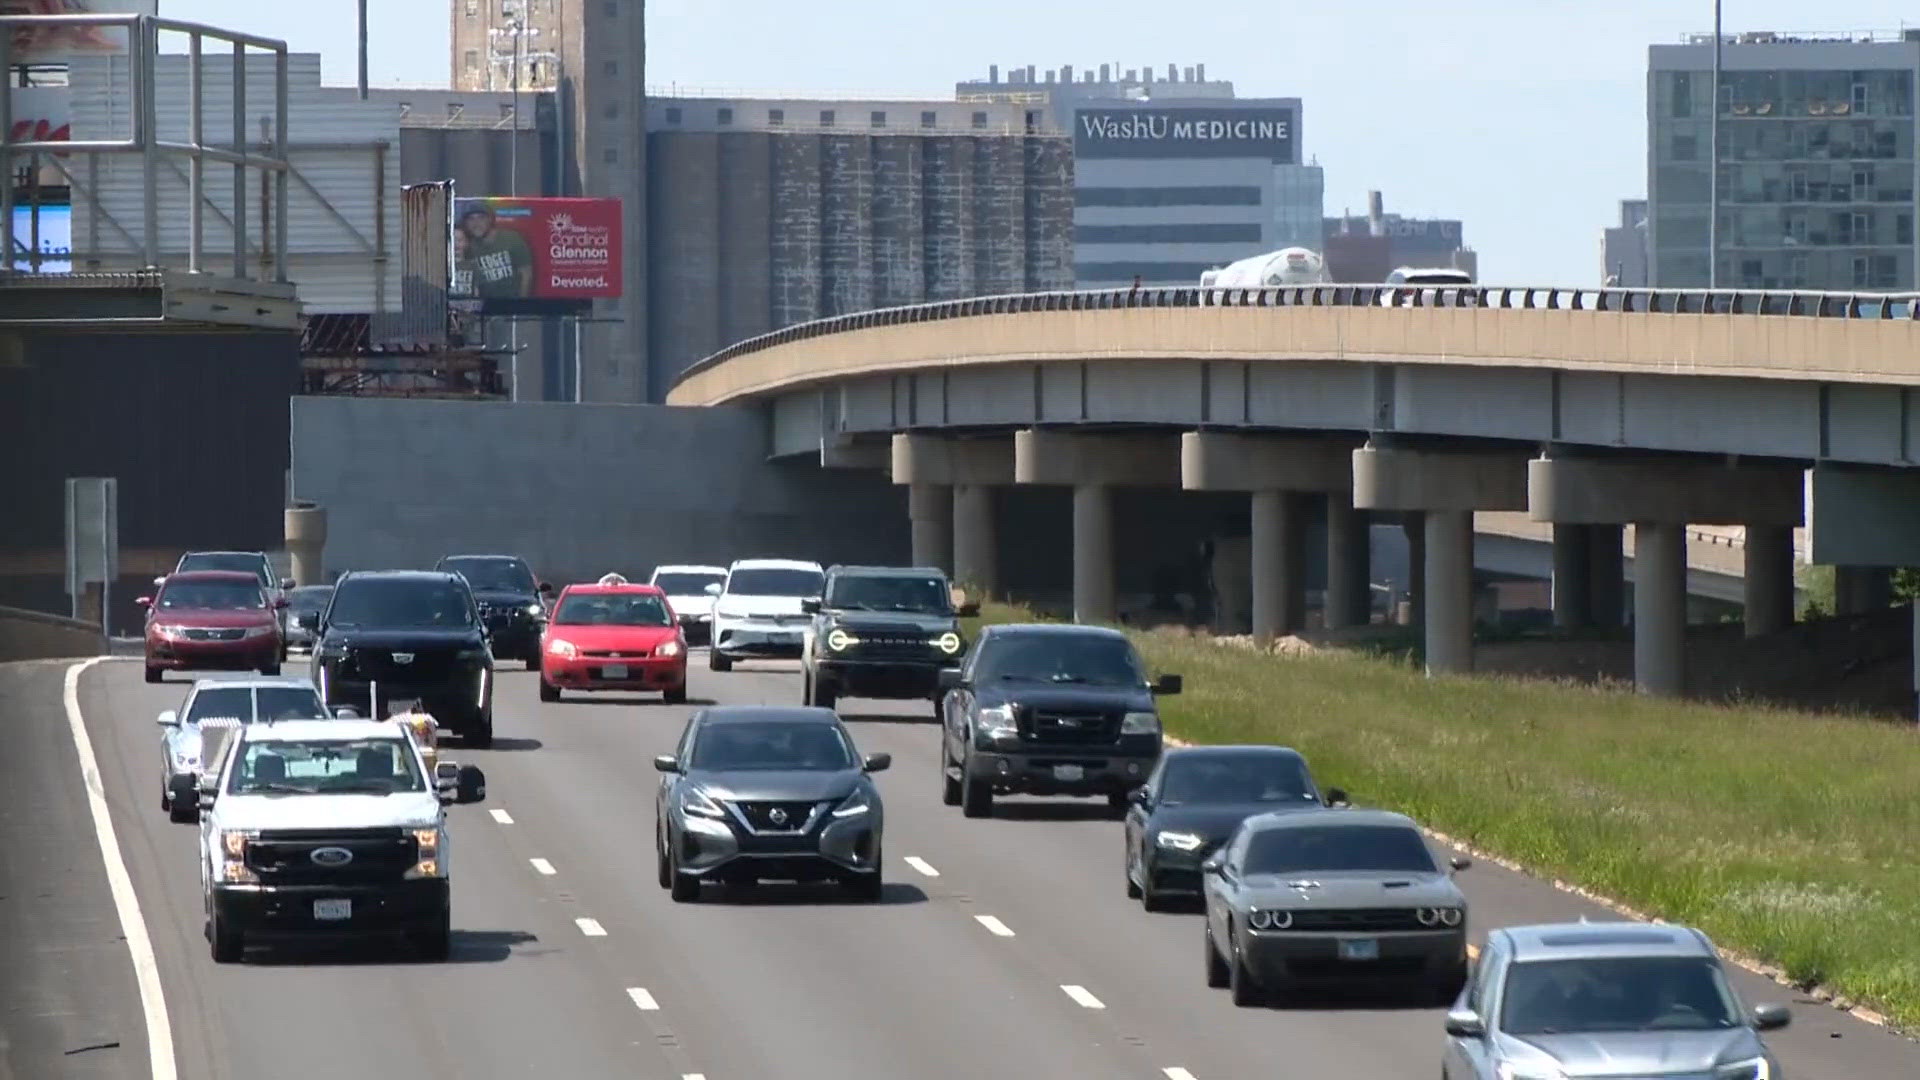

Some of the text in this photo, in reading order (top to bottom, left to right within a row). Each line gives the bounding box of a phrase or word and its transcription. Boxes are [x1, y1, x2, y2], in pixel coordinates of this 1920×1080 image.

[1081, 114, 1288, 139] WashU MEDICINE
[550, 233, 608, 246] Cardinal
[550, 245, 608, 258] Glennon
[551, 275, 609, 288] Devoted.
